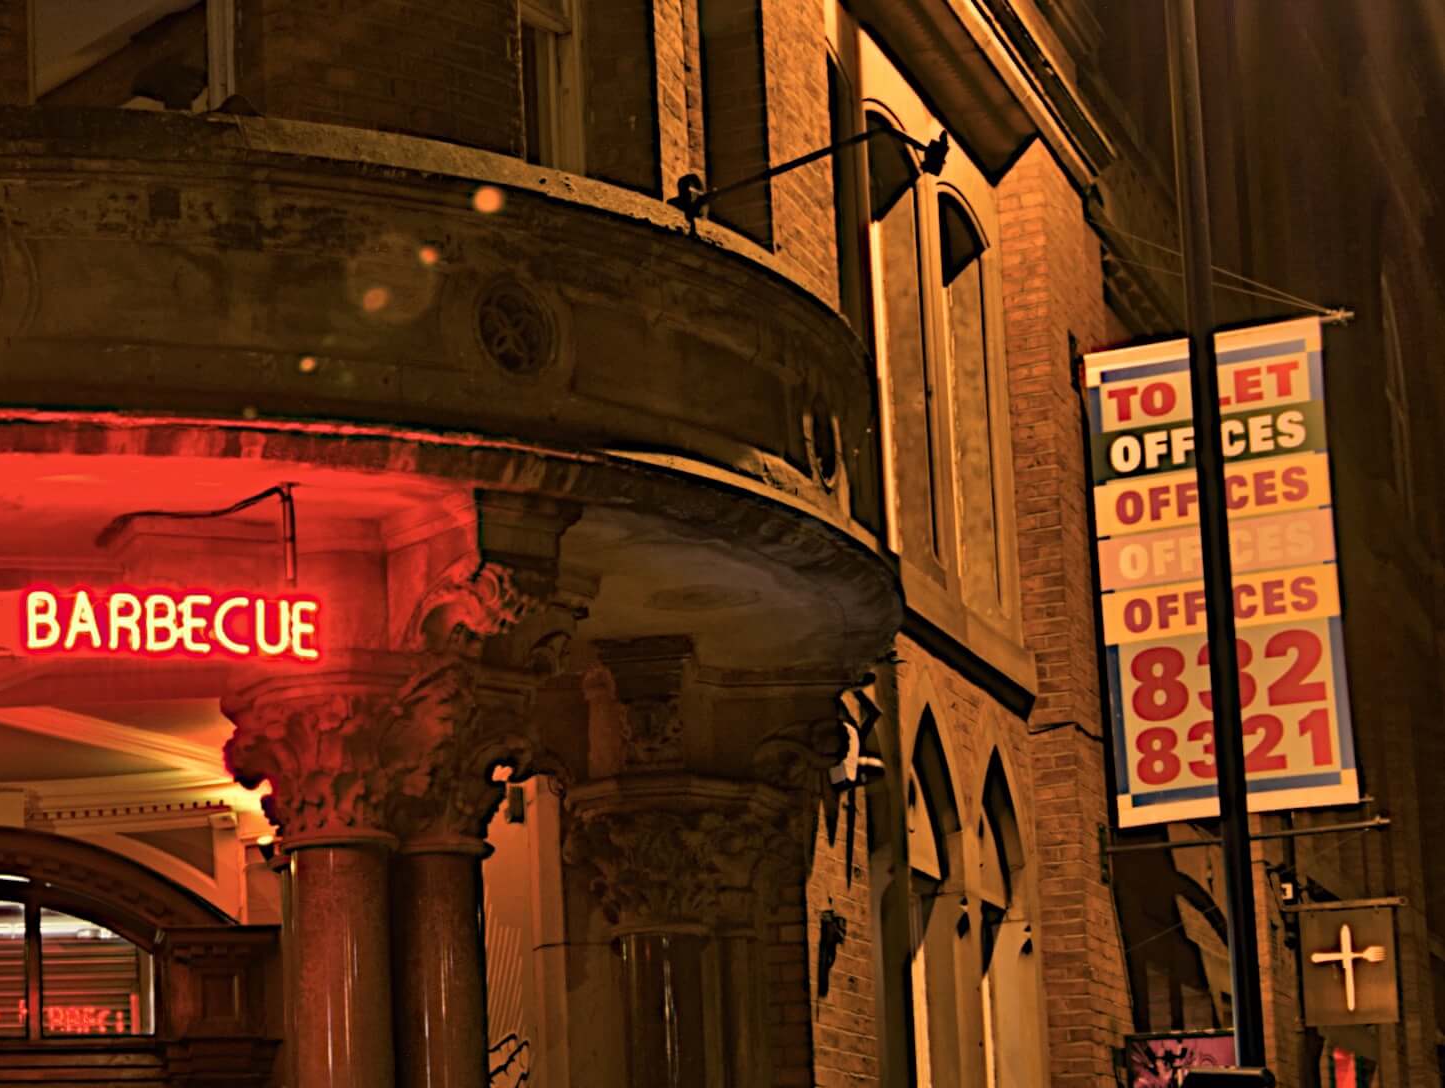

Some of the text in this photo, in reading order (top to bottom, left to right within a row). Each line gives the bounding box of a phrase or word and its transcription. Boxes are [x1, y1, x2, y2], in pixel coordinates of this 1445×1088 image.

[1107, 361, 1299, 422] TO ET
[1110, 410, 1307, 473] OFFCES
[1115, 465, 1310, 525] OFFCES
[1118, 521, 1316, 580] OFFCES
[25, 588, 321, 660] BARBECUE
[1123, 575, 1319, 634] OFFCES
[1135, 708, 1335, 785] 8321
